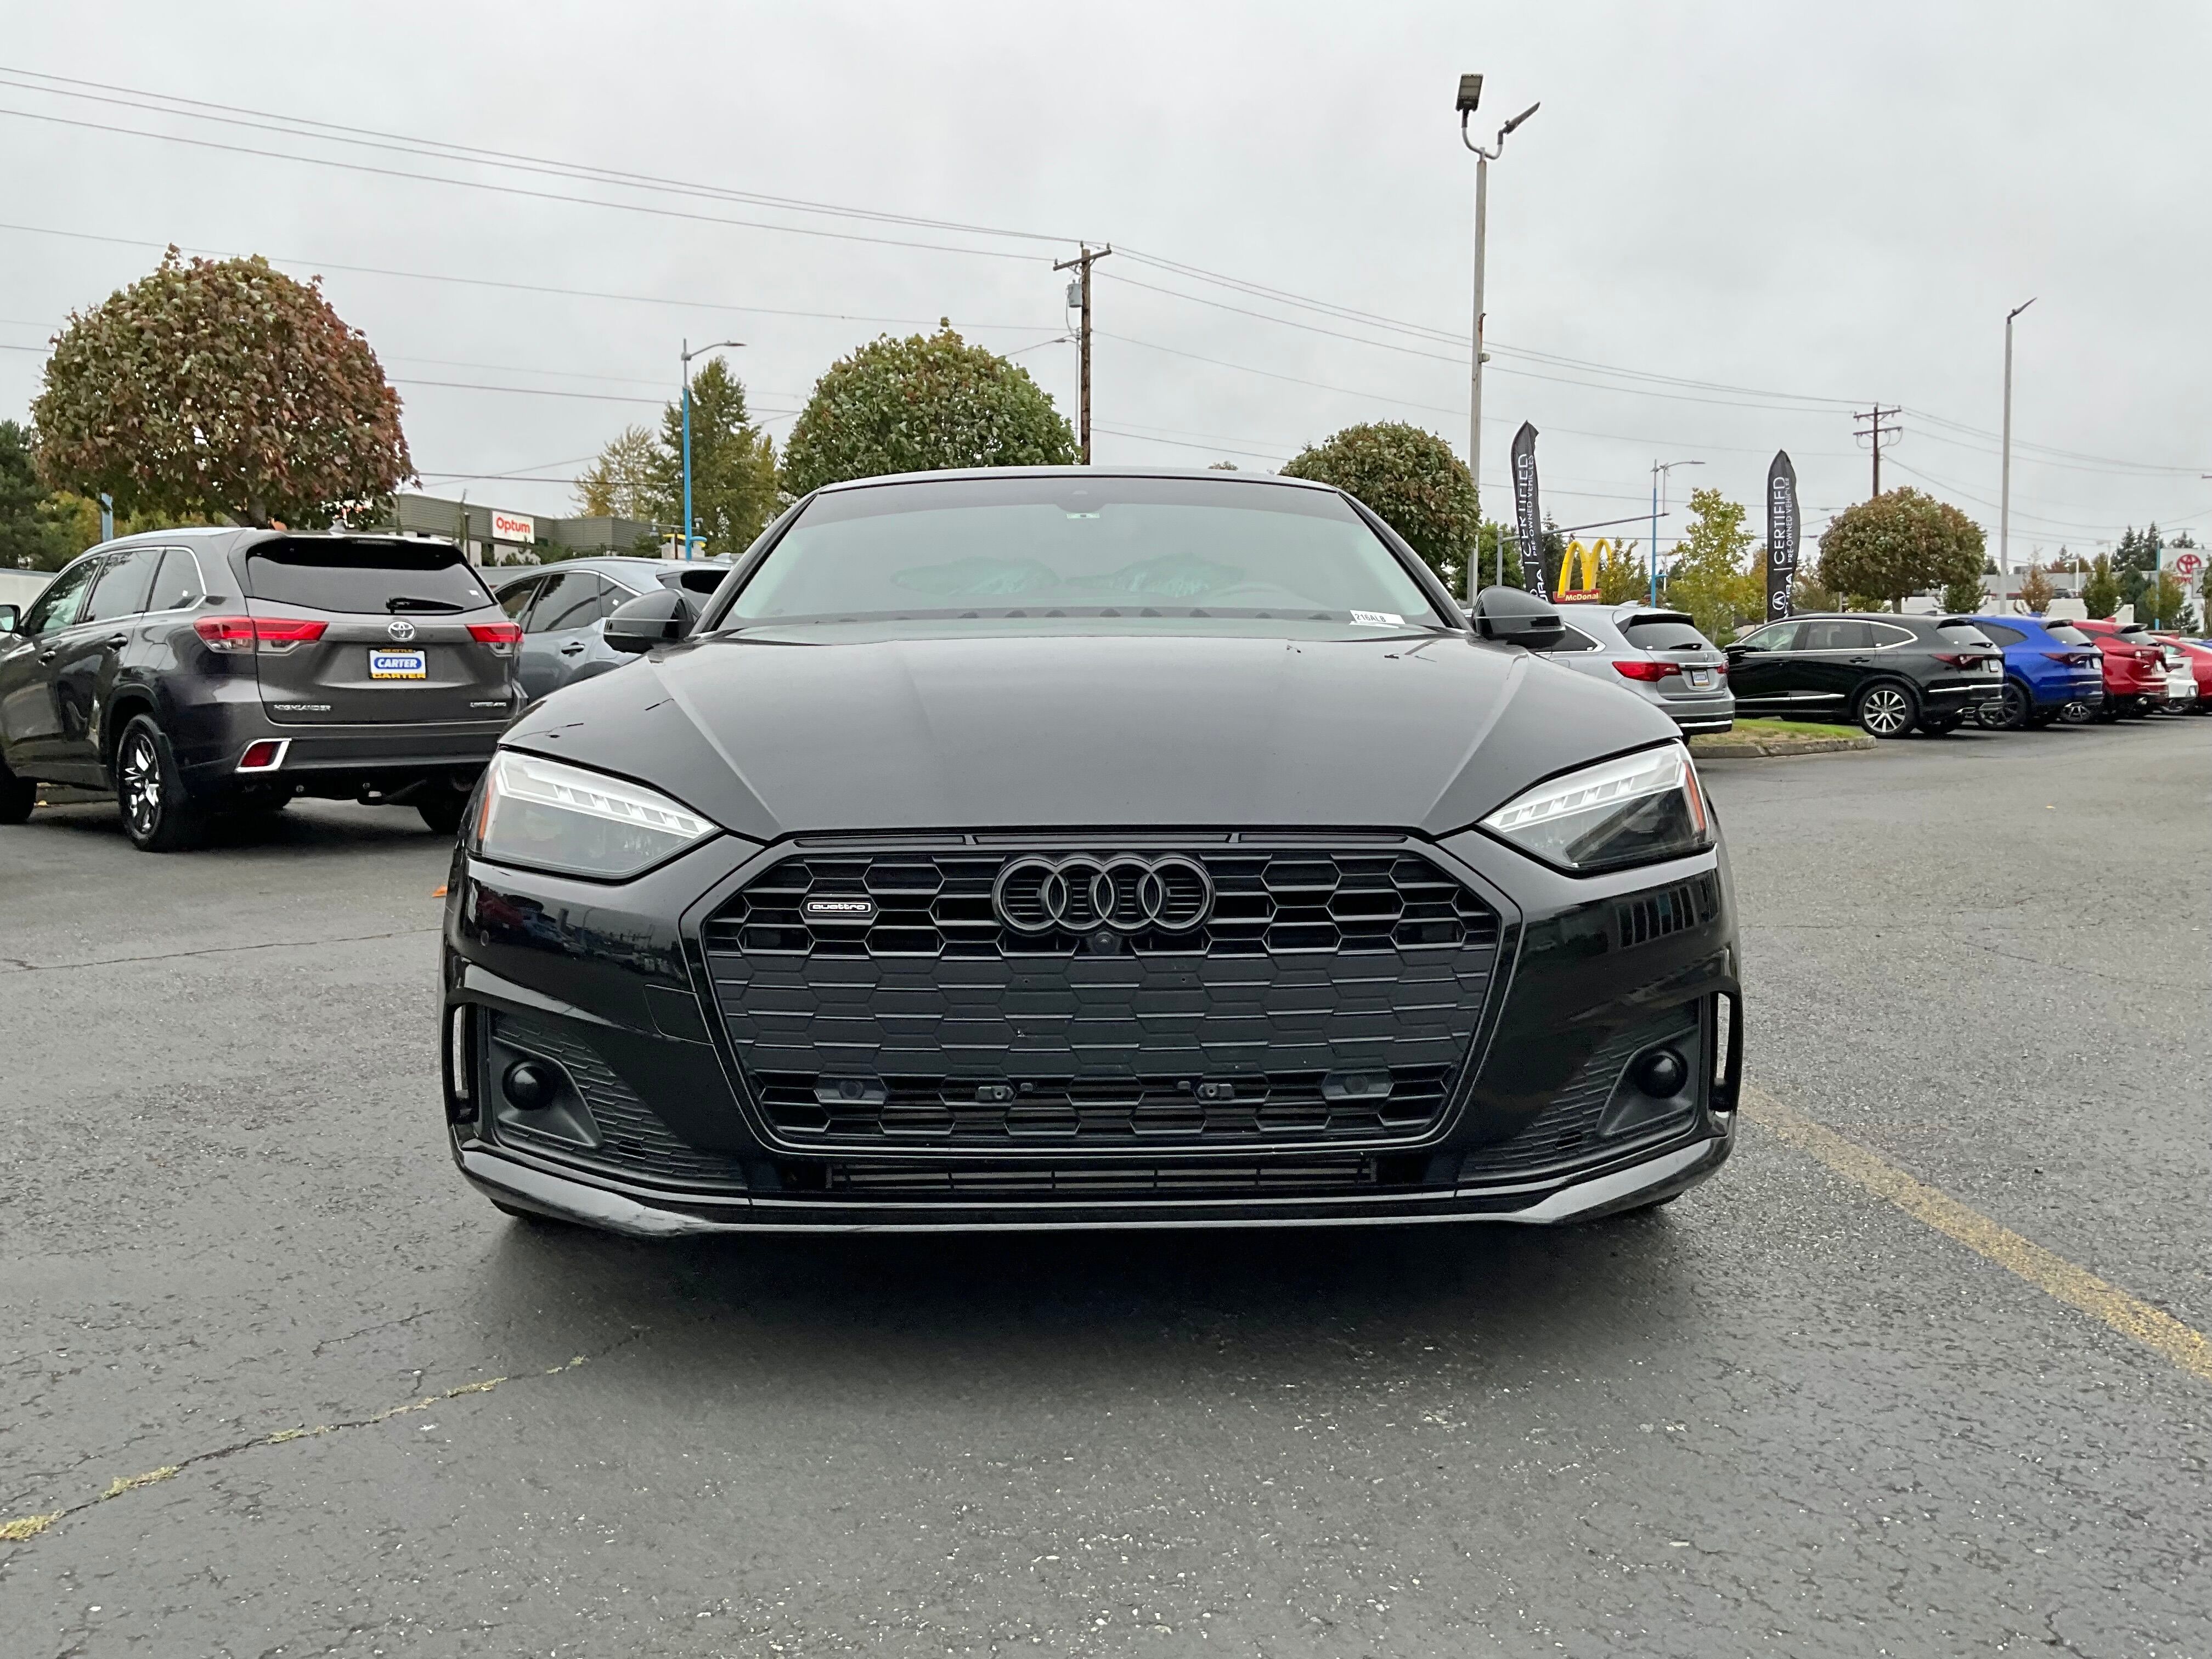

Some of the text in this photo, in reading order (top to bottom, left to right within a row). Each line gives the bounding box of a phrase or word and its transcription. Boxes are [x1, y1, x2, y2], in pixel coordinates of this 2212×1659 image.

[496, 517, 531, 534] Optum
[1773, 477, 1785, 565] CERTIFIED
[1785, 516, 1794, 563] PRE-OWNED
[1565, 592, 1599, 601] McDonal
[377, 658, 417, 668] CARTER
